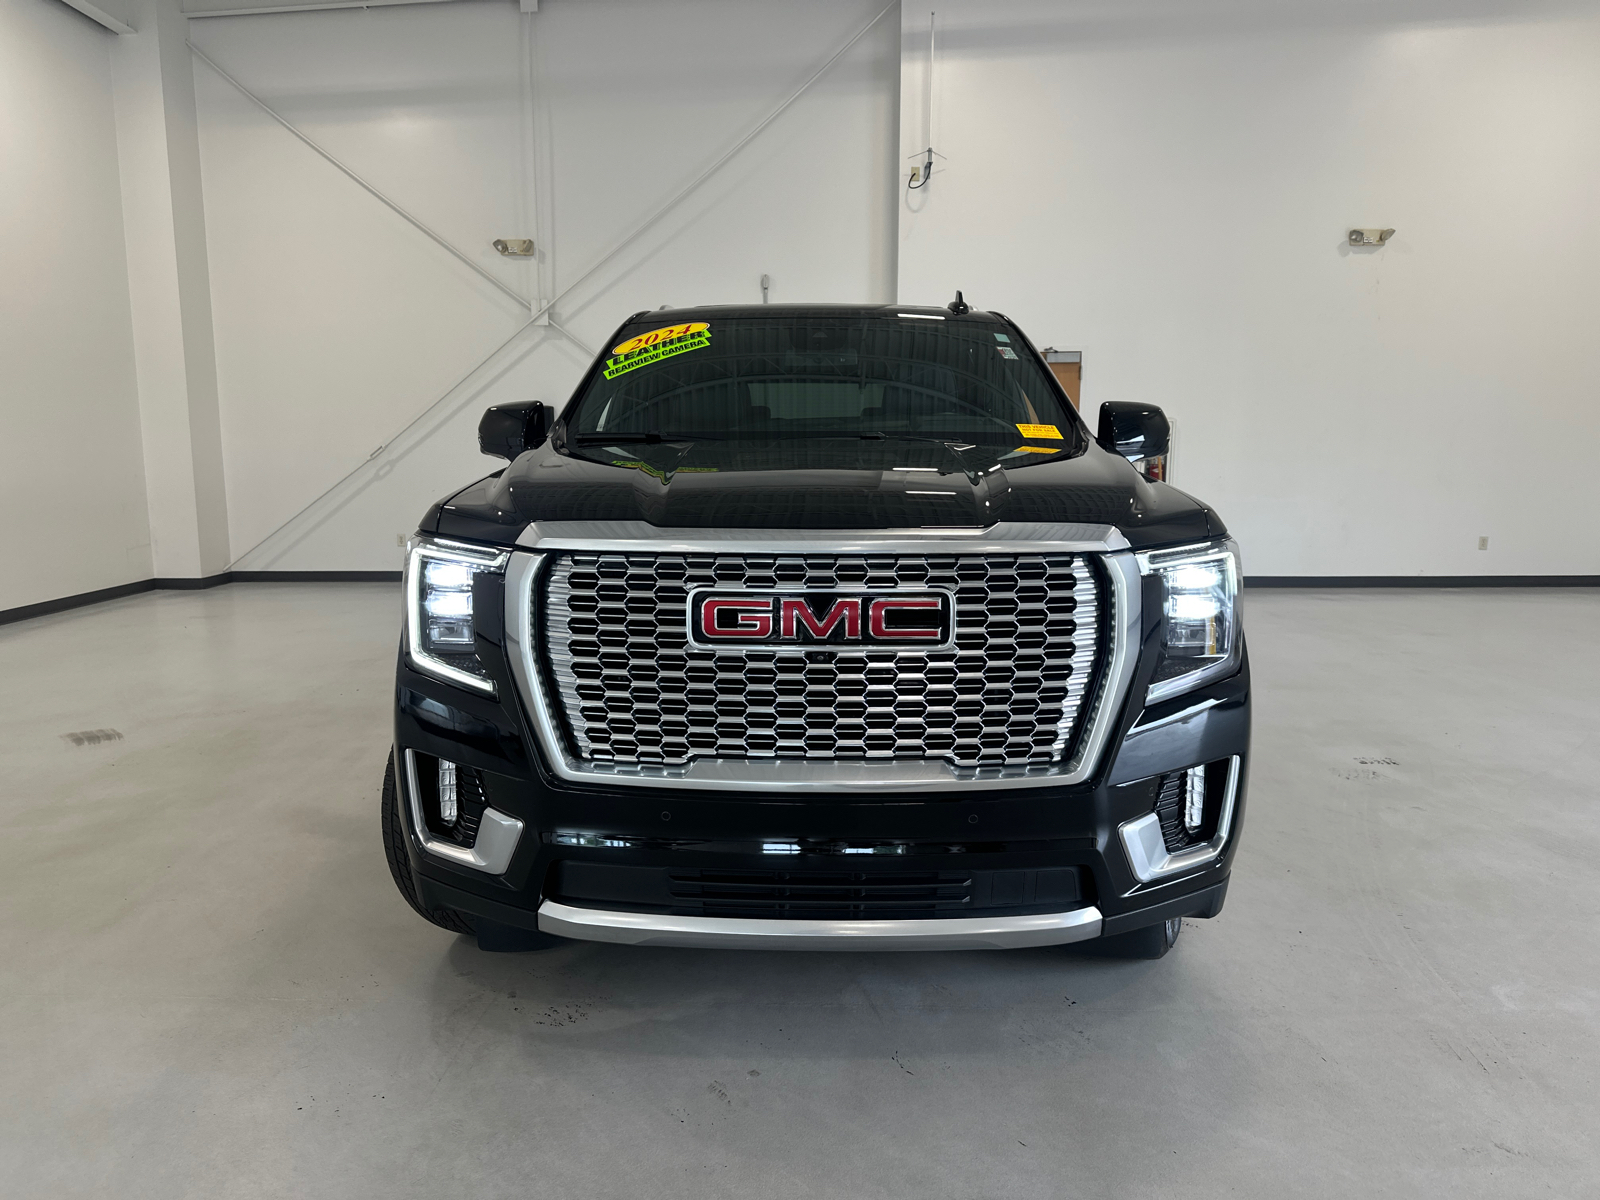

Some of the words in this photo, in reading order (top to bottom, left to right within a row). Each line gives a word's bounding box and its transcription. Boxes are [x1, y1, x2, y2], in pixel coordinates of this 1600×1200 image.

[612, 330, 706, 367] LEATHER
[629, 324, 692, 352] 2024
[607, 352, 660, 377] REARVIEW
[661, 339, 704, 357] CAMERA
[701, 597, 942, 640] GMC
